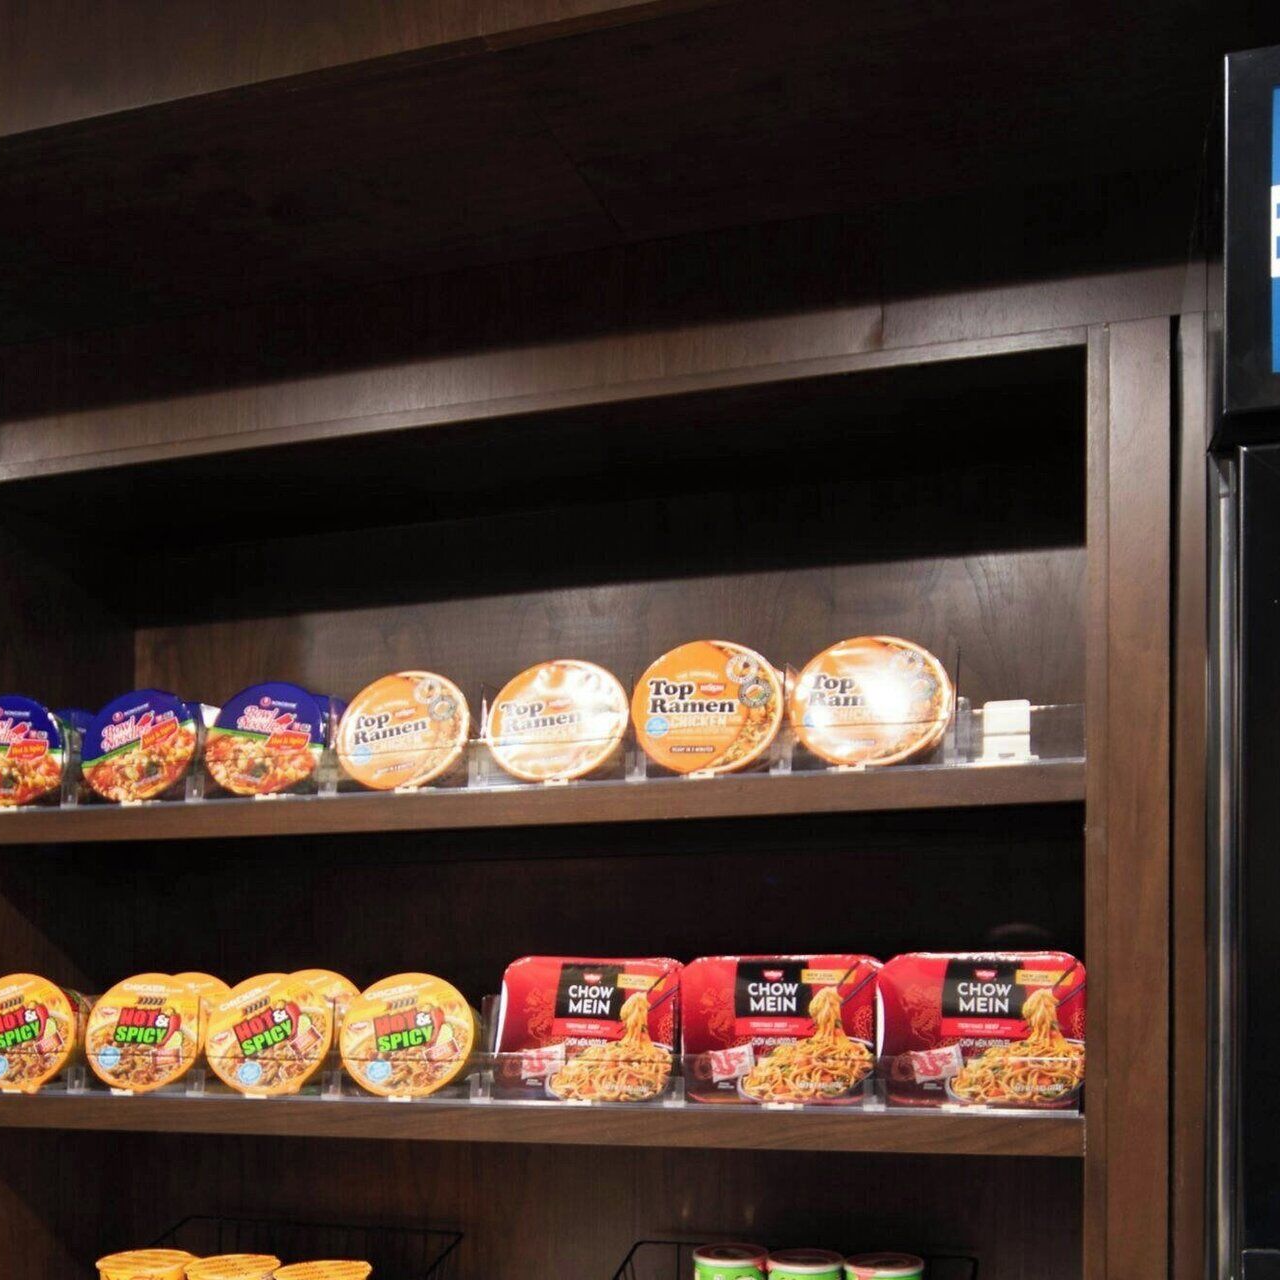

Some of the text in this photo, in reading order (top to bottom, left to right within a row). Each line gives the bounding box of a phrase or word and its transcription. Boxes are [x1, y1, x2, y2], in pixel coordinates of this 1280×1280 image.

[650, 680, 694, 699] Top
[813, 675, 854, 693] Top
[501, 704, 543, 717] Top
[650, 699, 734, 713] Ramen
[356, 714, 389, 729] Top
[354, 720, 427, 745] Ramen
[569, 985, 614, 999] CHOW
[748, 983, 798, 996] CHOW
[957, 983, 1012, 996] CHOW
[569, 1000, 610, 1015] MEIN
[750, 998, 796, 1012] MEIN
[959, 998, 1009, 1013] MEIN
[24, 1009, 38, 1022] &
[120, 1007, 169, 1027] HOT &
[374, 1010, 431, 1034] HOT &
[234, 1008, 289, 1040] HOT &
[115, 1026, 166, 1043] SPICY
[240, 1019, 292, 1056] SPICY
[377, 1026, 433, 1053] SPICY
